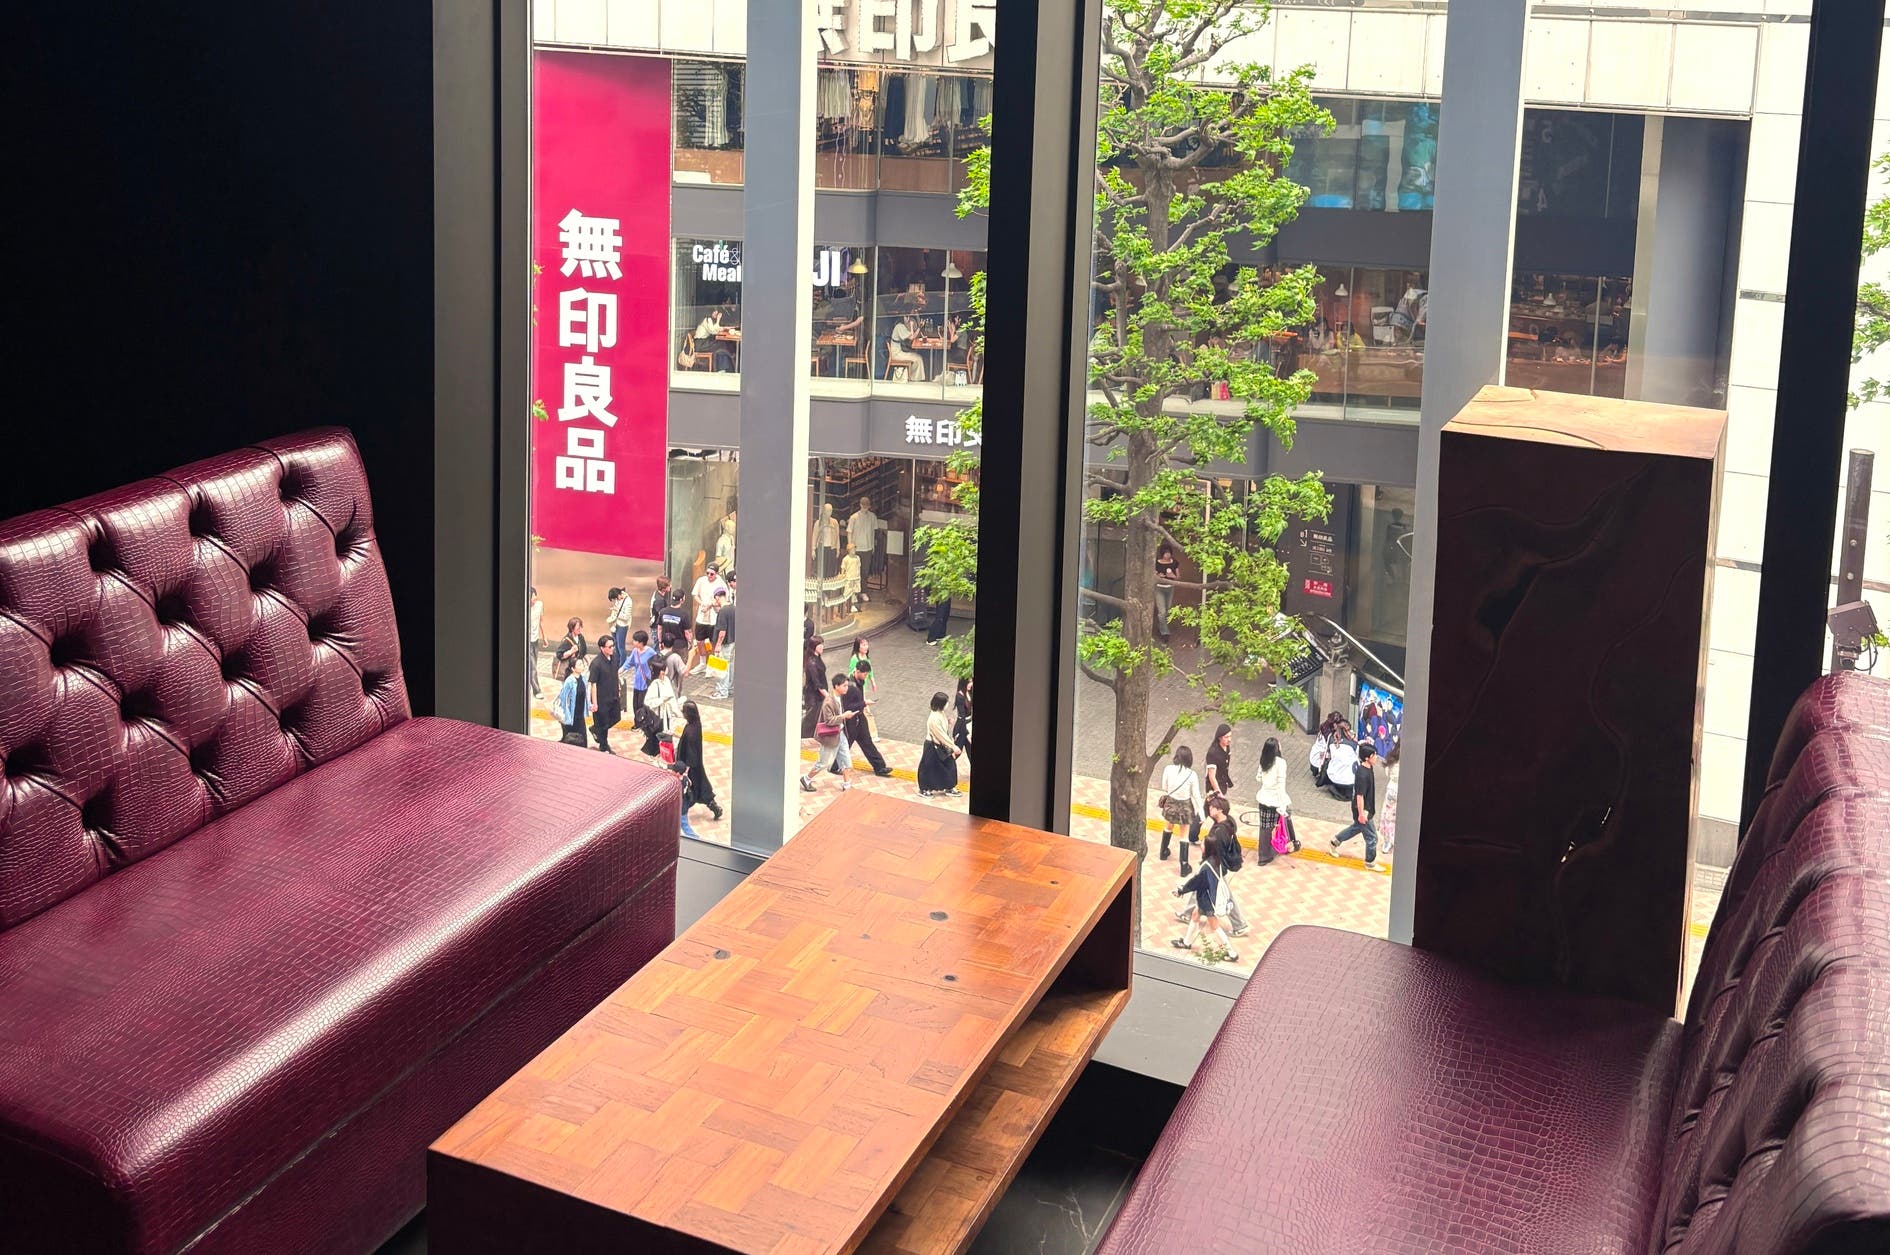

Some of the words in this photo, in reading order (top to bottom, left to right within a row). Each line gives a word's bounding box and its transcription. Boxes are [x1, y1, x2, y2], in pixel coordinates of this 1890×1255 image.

[702, 263, 742, 283] Meal
[556, 208, 623, 495] 無印良品
